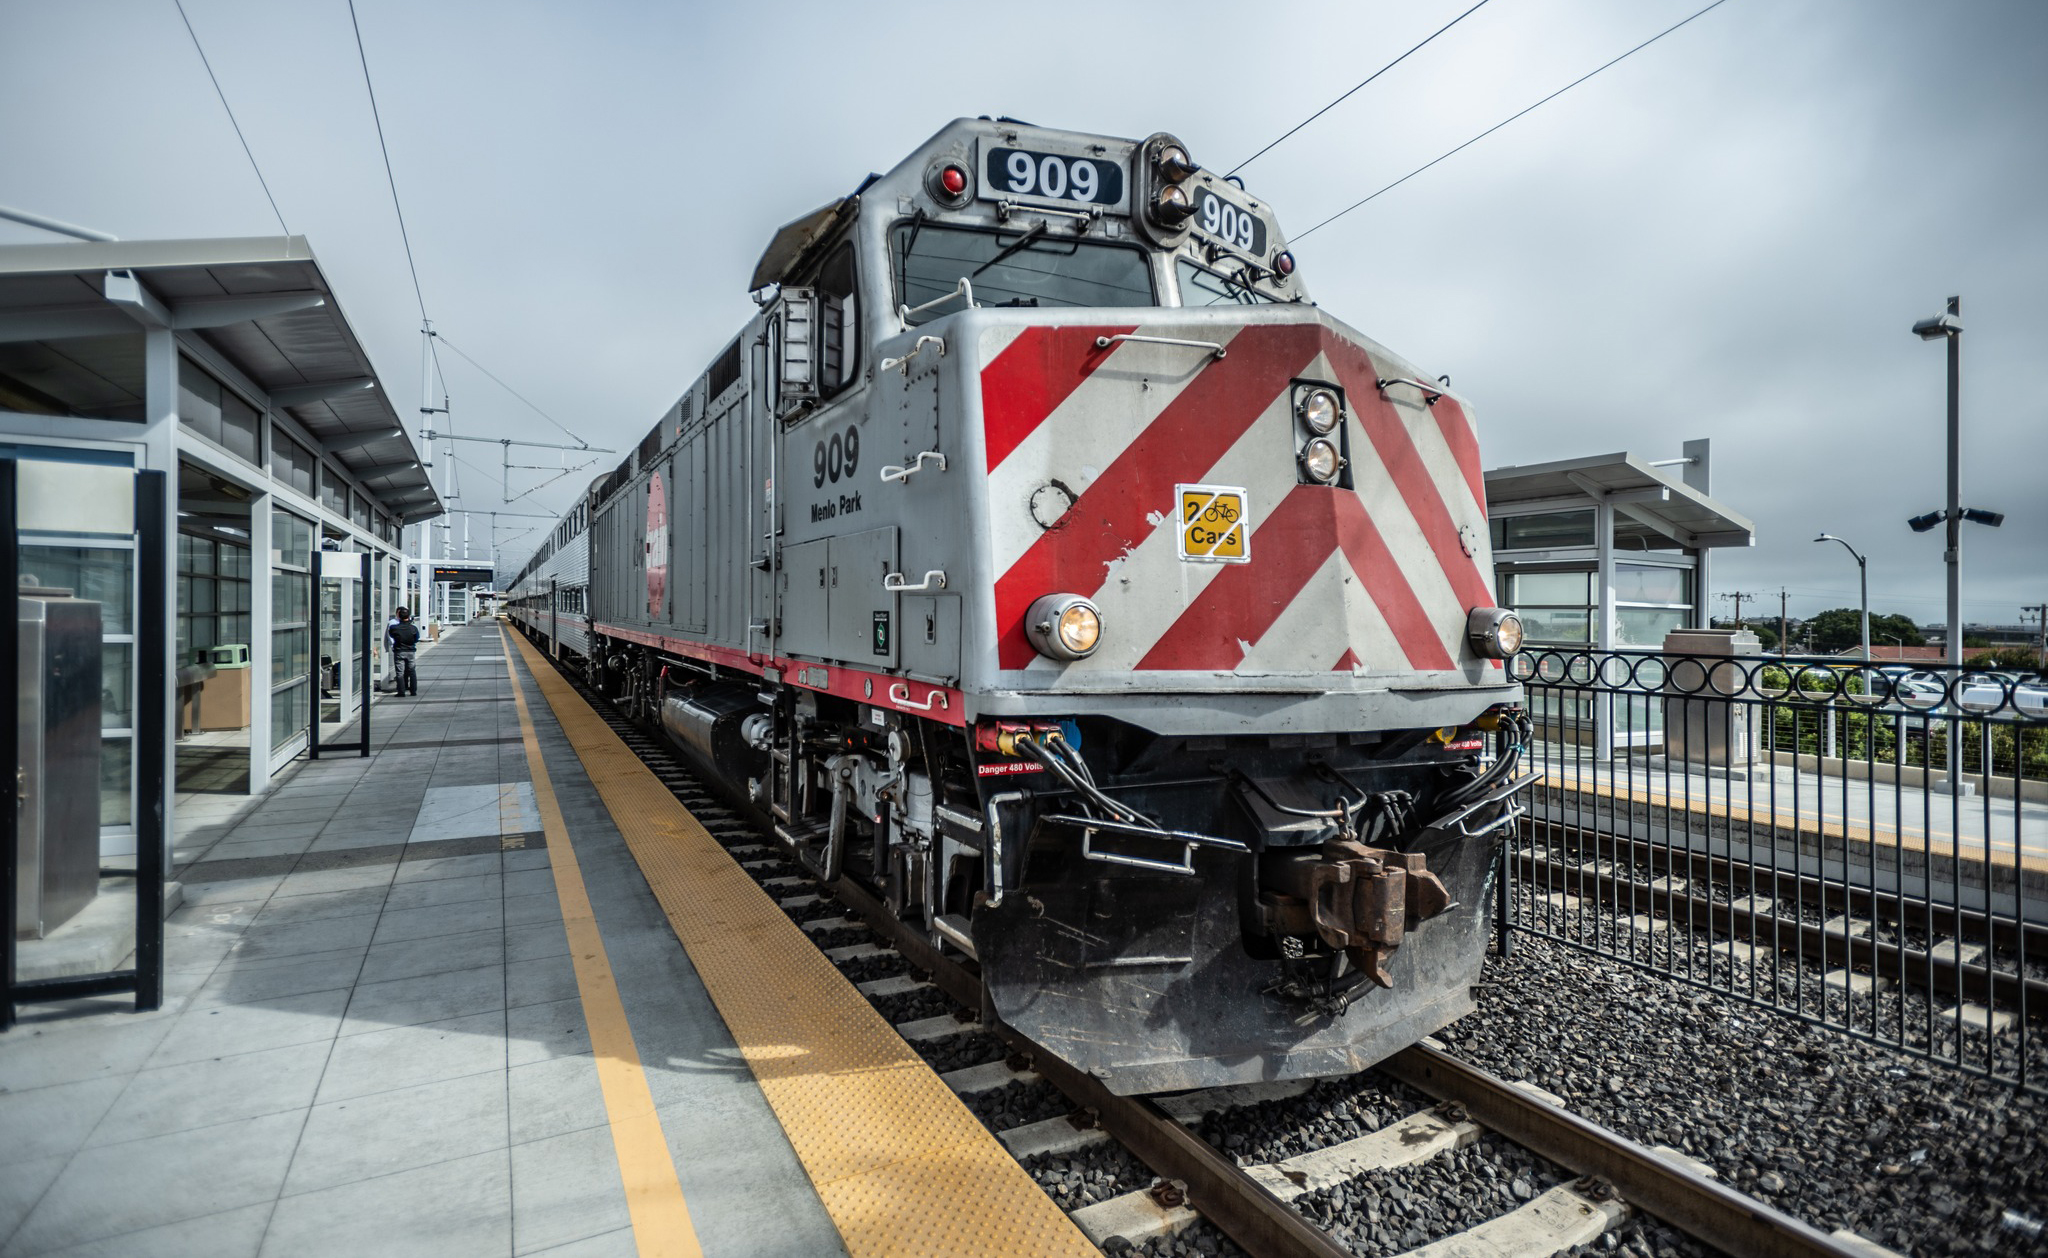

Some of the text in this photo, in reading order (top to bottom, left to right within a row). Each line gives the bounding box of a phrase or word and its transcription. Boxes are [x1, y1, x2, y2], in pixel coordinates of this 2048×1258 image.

[1007, 151, 1099, 202] 909
[1204, 193, 1254, 251] 909
[813, 424, 860, 489] 909
[811, 490, 862, 524] Menlo Park
[1187, 501, 1201, 522] 2
[1190, 526, 1237, 546] Cars
[978, 762, 1044, 775] Danger 480 Volts
